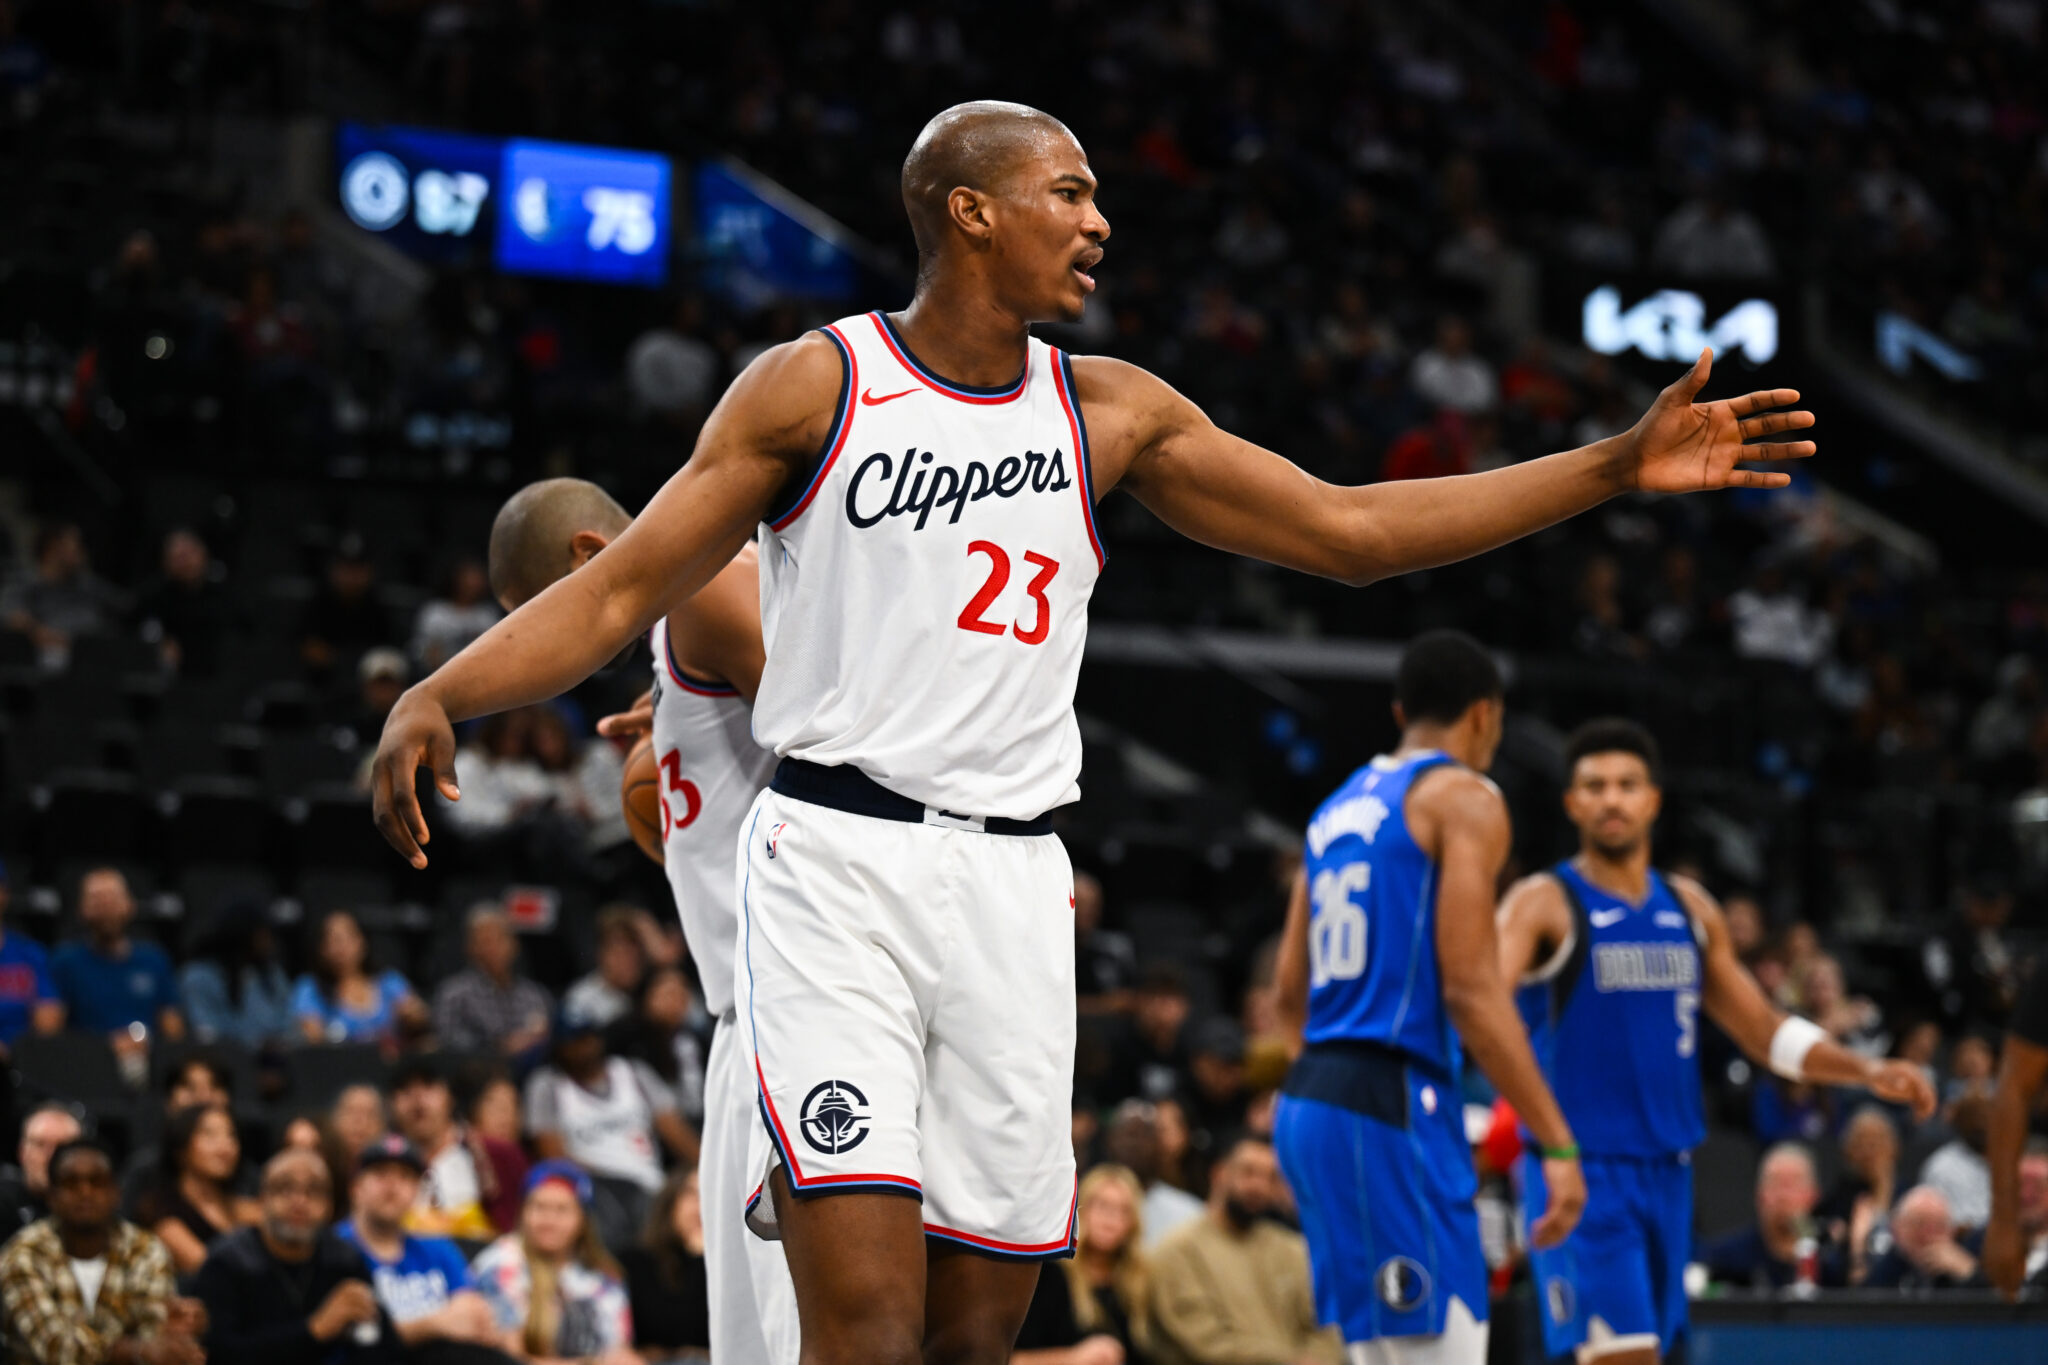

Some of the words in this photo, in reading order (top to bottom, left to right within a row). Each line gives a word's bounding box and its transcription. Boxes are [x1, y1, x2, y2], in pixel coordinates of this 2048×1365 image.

[584, 187, 656, 254] 75
[846, 448, 1072, 531] Clippers
[957, 540, 1060, 645] 23
[1310, 861, 1372, 988] 26
